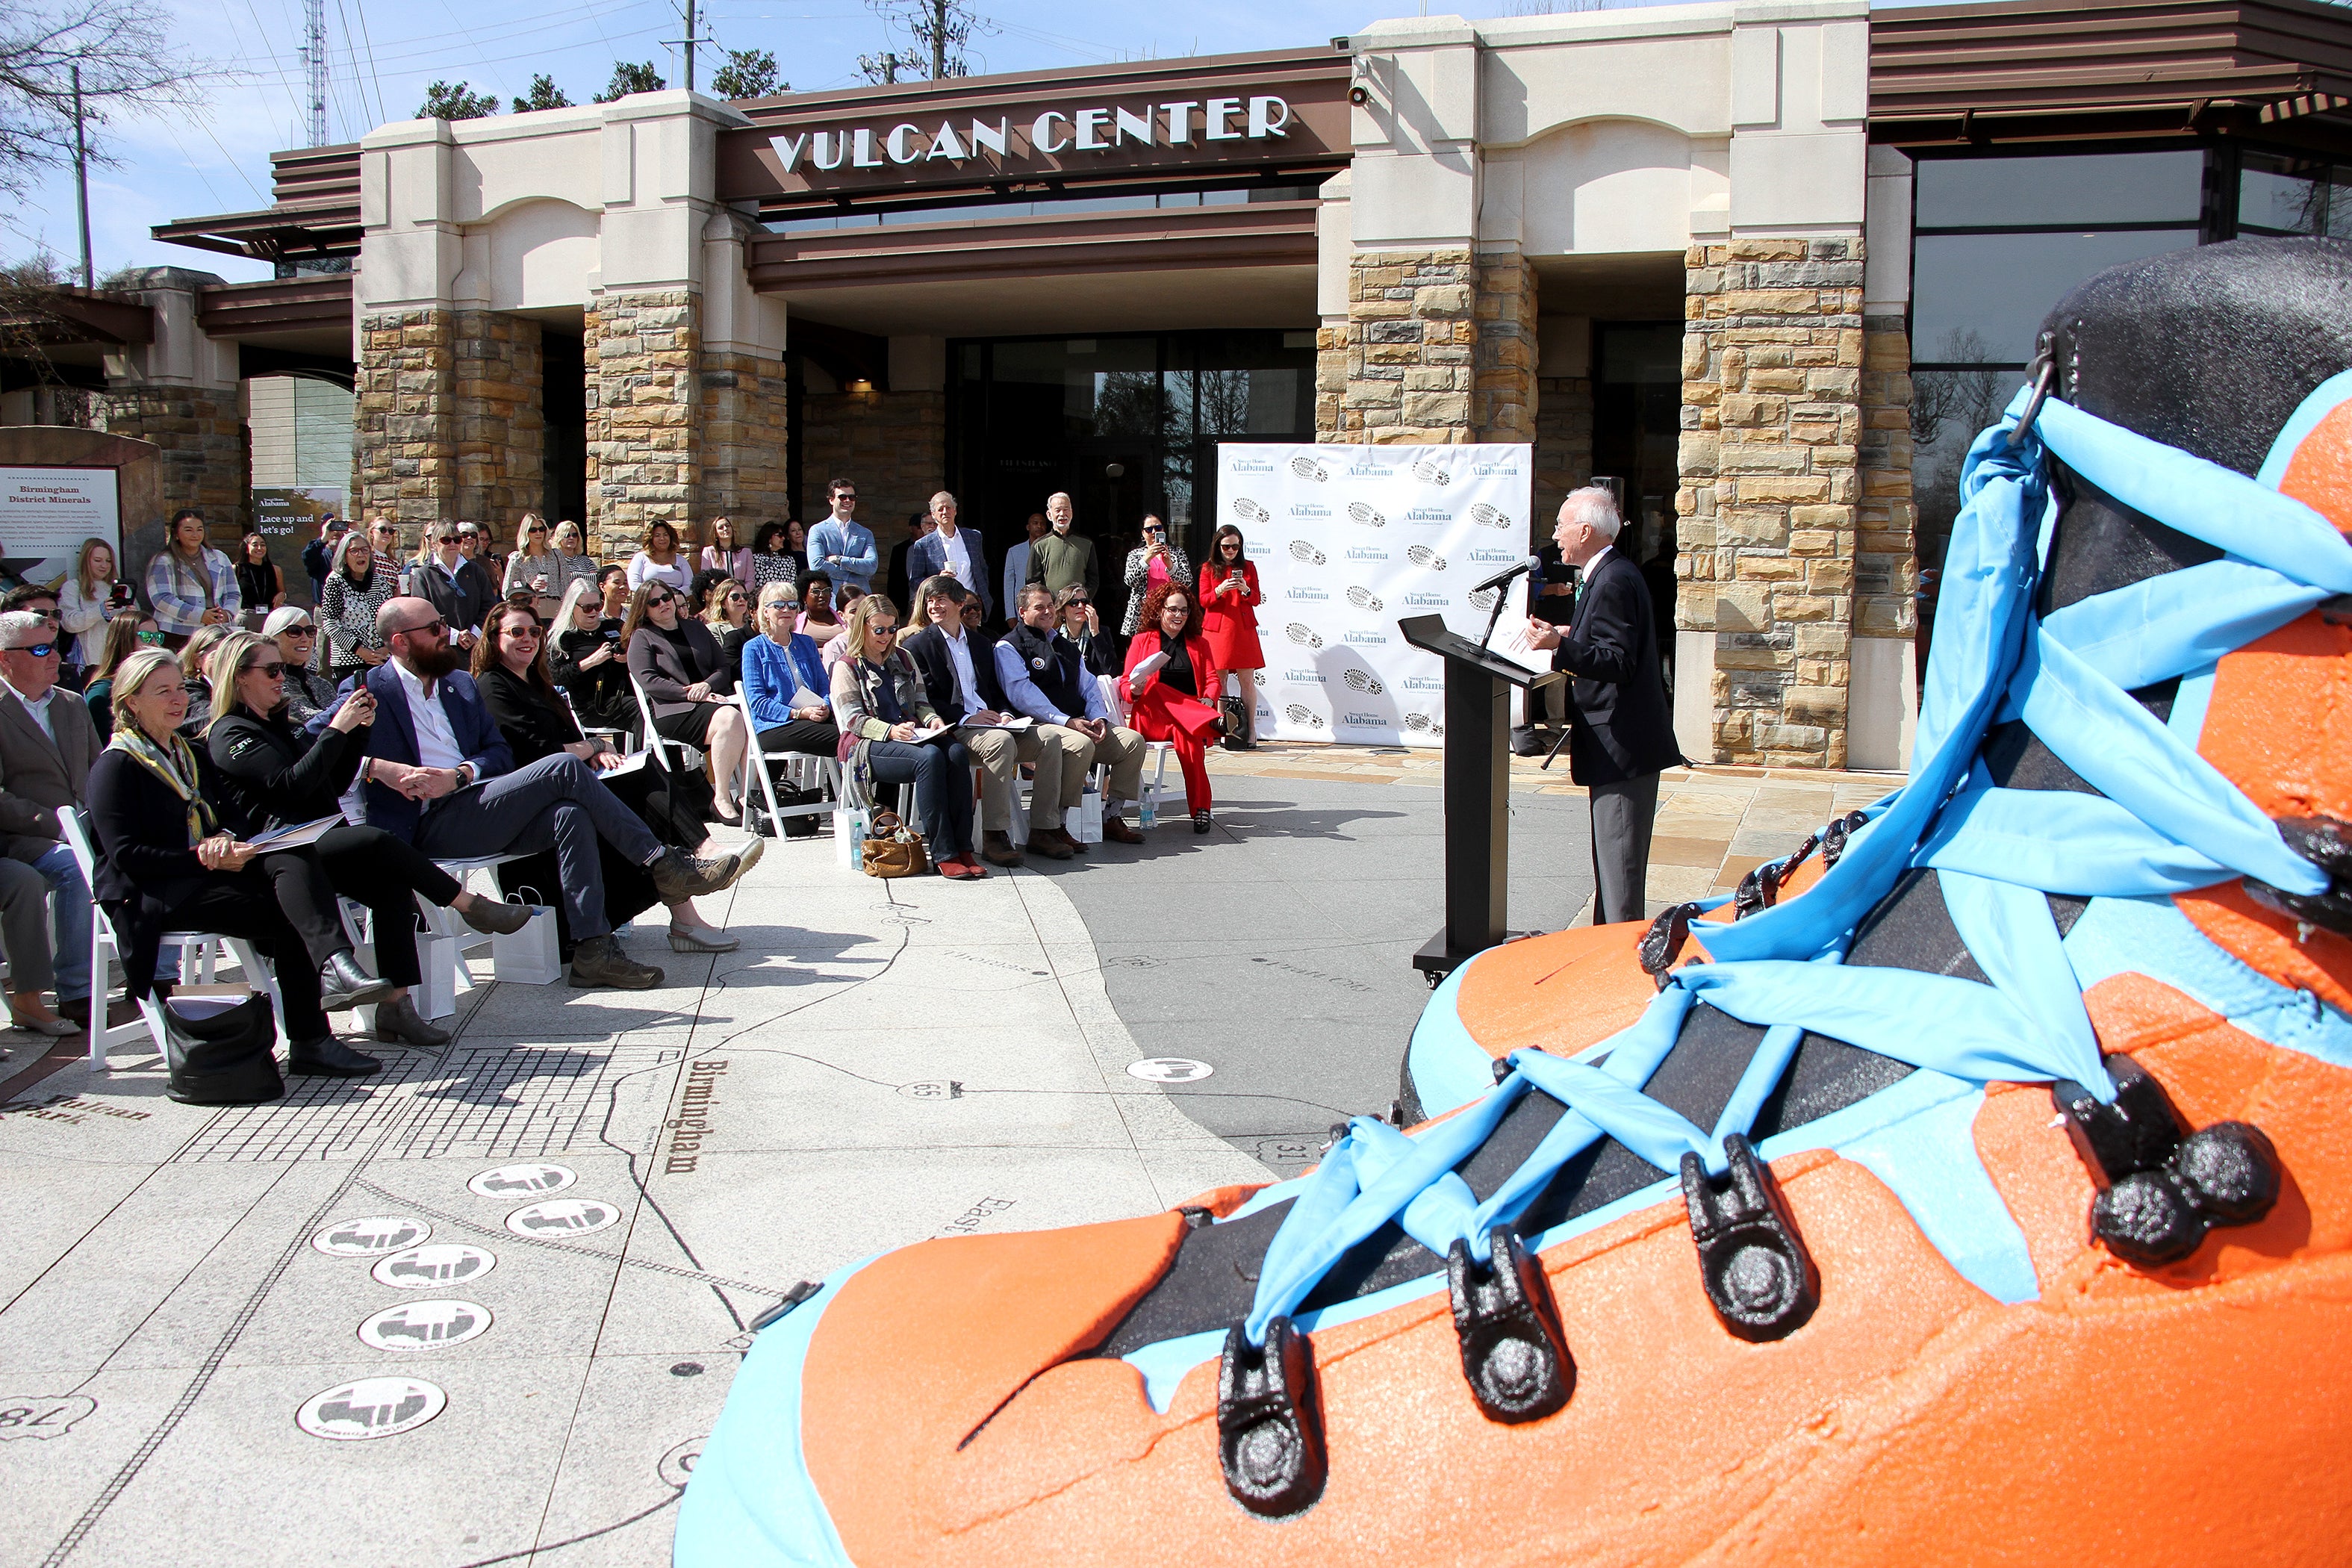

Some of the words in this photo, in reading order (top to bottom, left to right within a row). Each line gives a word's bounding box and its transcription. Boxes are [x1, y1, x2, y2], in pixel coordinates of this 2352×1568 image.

[768, 116, 1010, 173] VULCAN
[1031, 96, 1289, 153] CENTER
[1231, 463, 1273, 472] Alabama
[1347, 467, 1393, 476] Alabama
[19, 486, 80, 494] Birmingham
[1288, 508, 1331, 517] Alabama
[1404, 512, 1452, 521] Alabama
[296, 514, 314, 523] and
[260, 526, 279, 534] let's
[280, 526, 294, 535] go!
[1244, 545, 1271, 554] bama
[1344, 550, 1388, 560] Alabama
[1466, 553, 1515, 561] Alabama
[1284, 590, 1329, 600] Alabama
[1401, 596, 1449, 606] Alabama
[1341, 634, 1386, 644] Alabama
[1283, 673, 1326, 682] Alabama
[1343, 716, 1387, 726] Alabama
[913, 1084, 941, 1097] 65
[665, 1060, 729, 1175] Birmingham
[1277, 1145, 1307, 1159] 31
